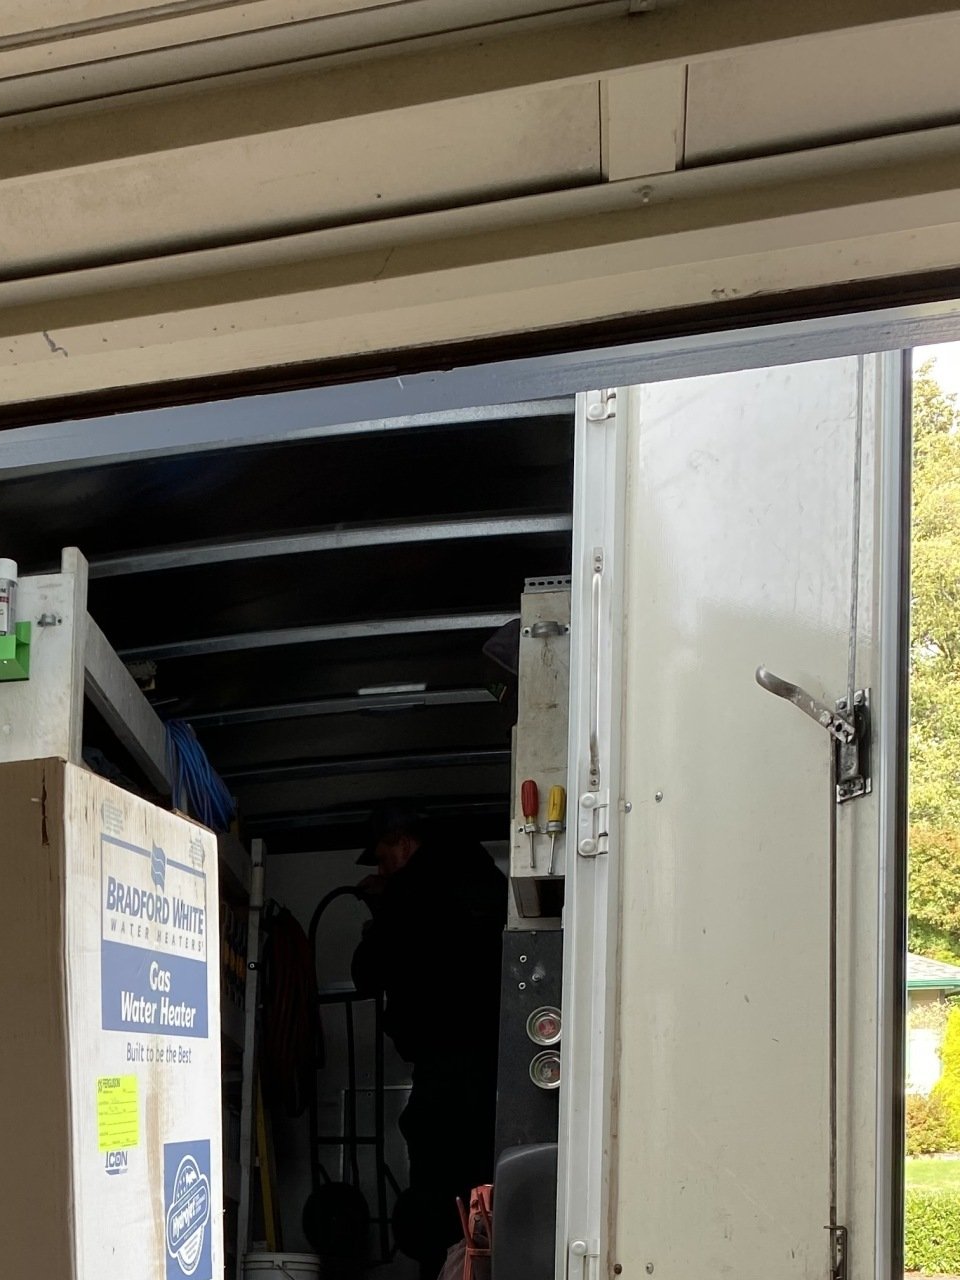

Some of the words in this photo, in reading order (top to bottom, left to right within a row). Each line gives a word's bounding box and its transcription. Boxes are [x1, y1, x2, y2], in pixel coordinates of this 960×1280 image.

[106, 876, 170, 925] BRADFORD
[172, 897, 204, 935] WHITE
[110, 918, 149, 939] WATER
[156, 929, 202, 952] HEATERS
[149, 961, 171, 993] Gas
[120, 991, 158, 1024] Water
[159, 996, 196, 1028] Heater
[126, 1042, 144, 1062] Built
[146, 1045, 154, 1062] to
[155, 1044, 164, 1063] be
[165, 1044, 177, 1063] the
[178, 1045, 192, 1063] Best
[105, 1150, 129, 1169] ICON
